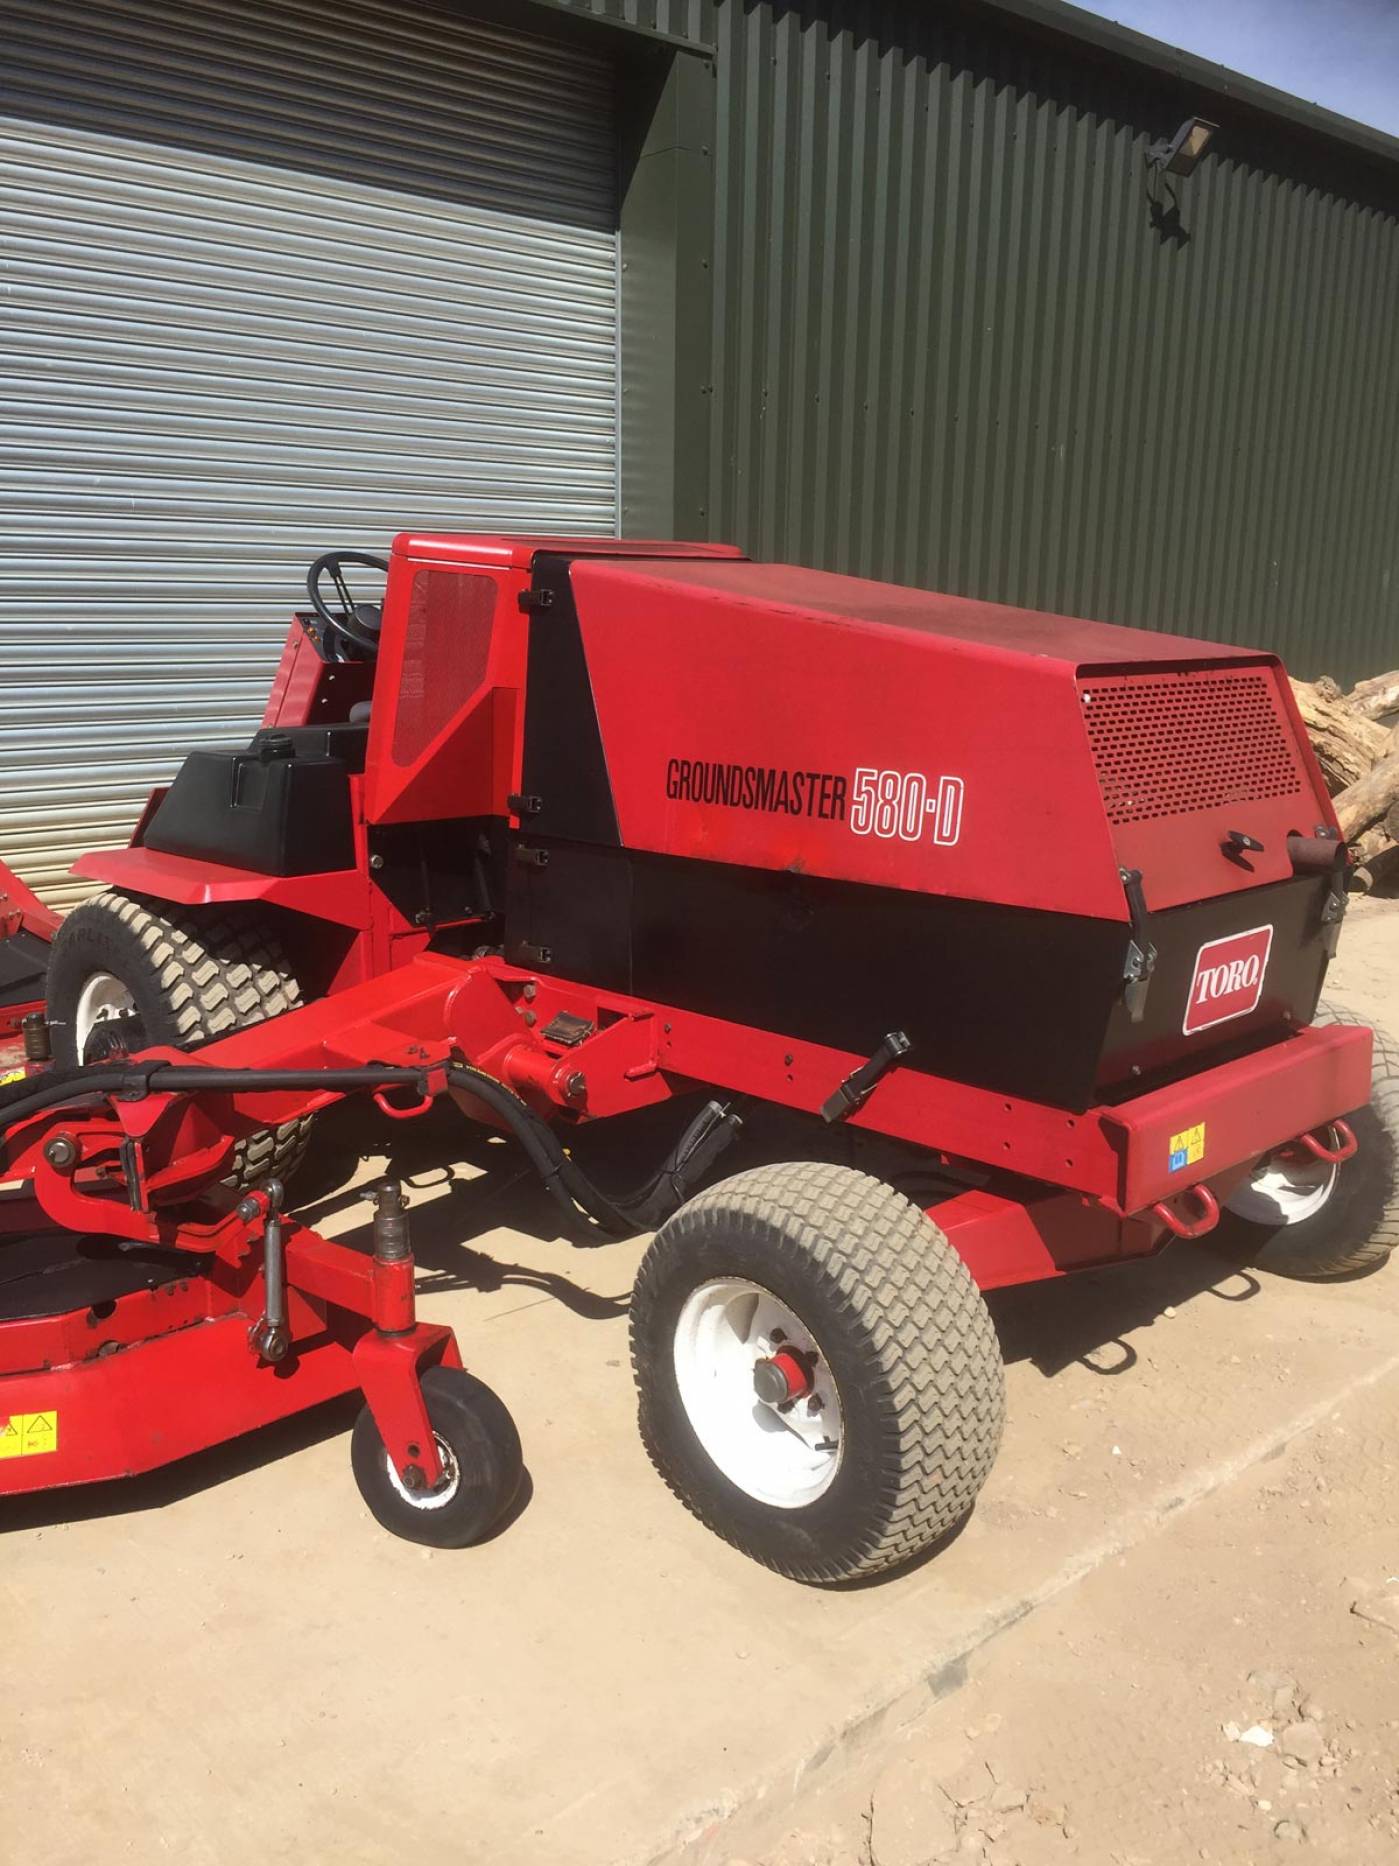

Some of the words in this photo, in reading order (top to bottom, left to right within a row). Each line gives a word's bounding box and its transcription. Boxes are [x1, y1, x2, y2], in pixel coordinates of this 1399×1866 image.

[666, 758, 847, 821] GROUNDSMASTER
[850, 767, 964, 846] 580-D
[1196, 954, 1260, 1004] TORO
